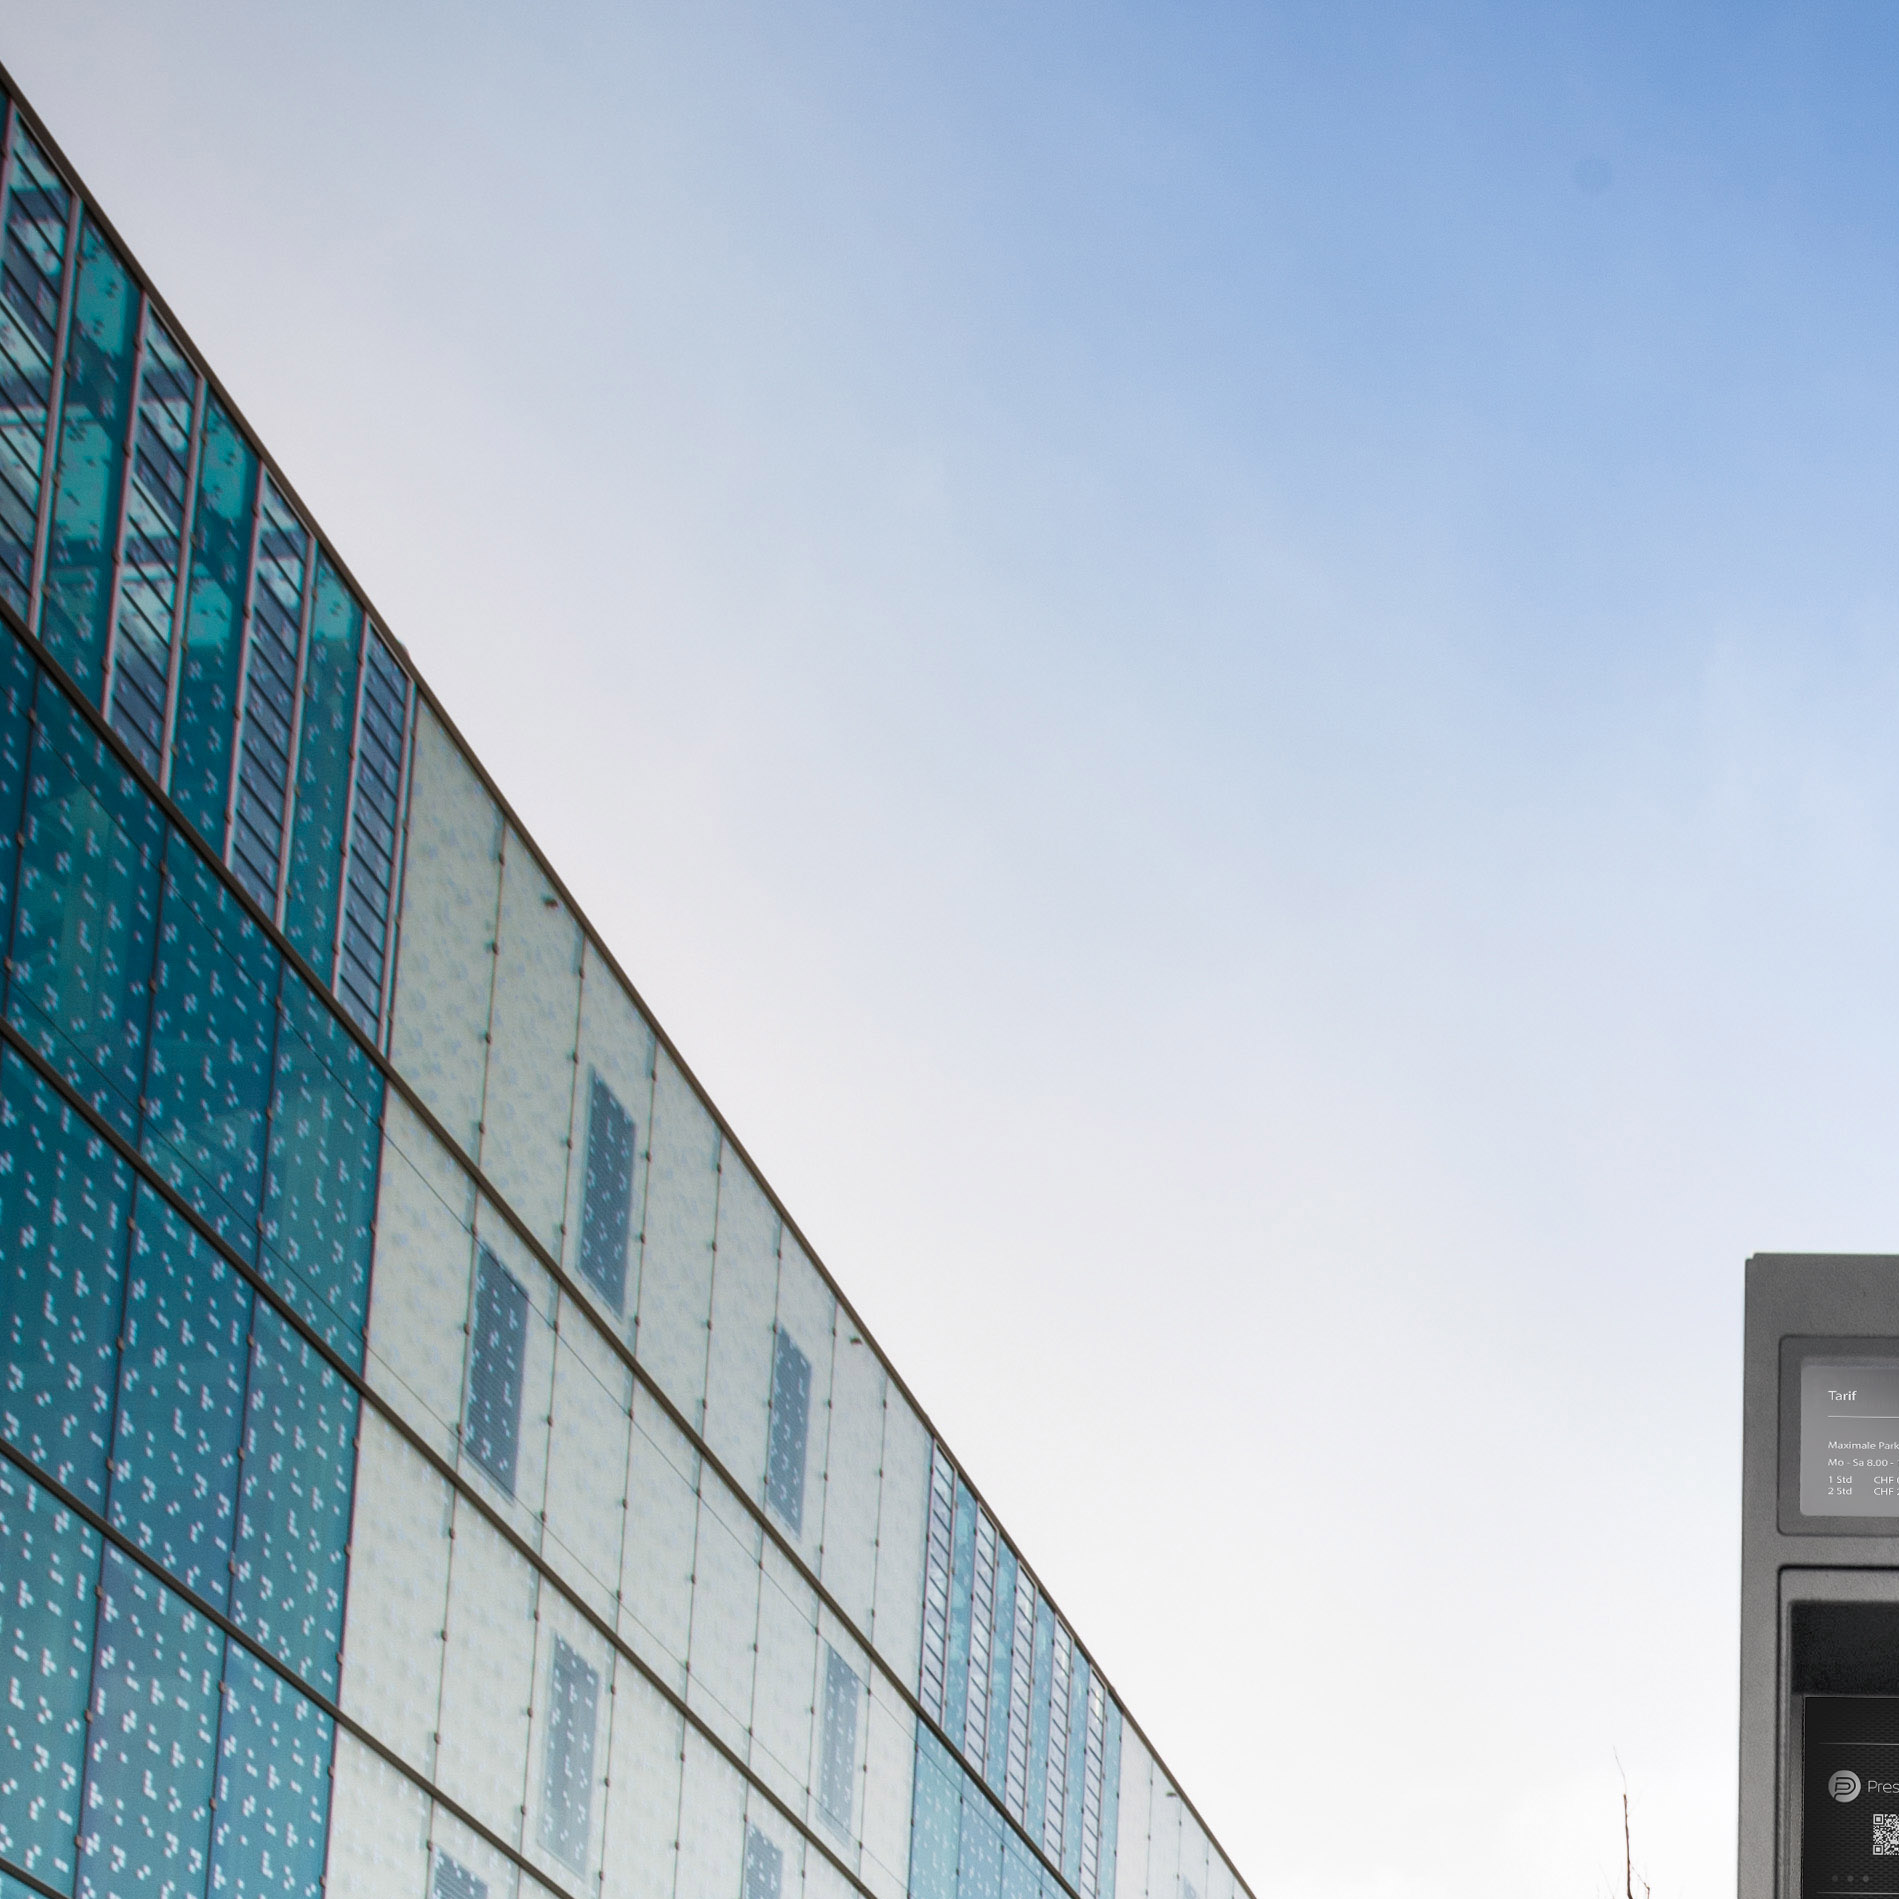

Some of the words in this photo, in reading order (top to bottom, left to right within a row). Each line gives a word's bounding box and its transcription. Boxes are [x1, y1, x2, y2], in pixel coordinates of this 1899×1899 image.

[1828, 1390, 1857, 1401] Tarif
[1827, 1441, 1876, 1450] Maximale
[1827, 1458, 1845, 1467] Mo
[1852, 1458, 1865, 1467] Sa
[1866, 1459, 1889, 1467] 8.00
[1836, 1475, 1853, 1484] Std
[1873, 1476, 1894, 1485] CHF
[1827, 1487, 1834, 1495] 2
[1836, 1487, 1853, 1495] Std
[1873, 1487, 1894, 1496] CHF
